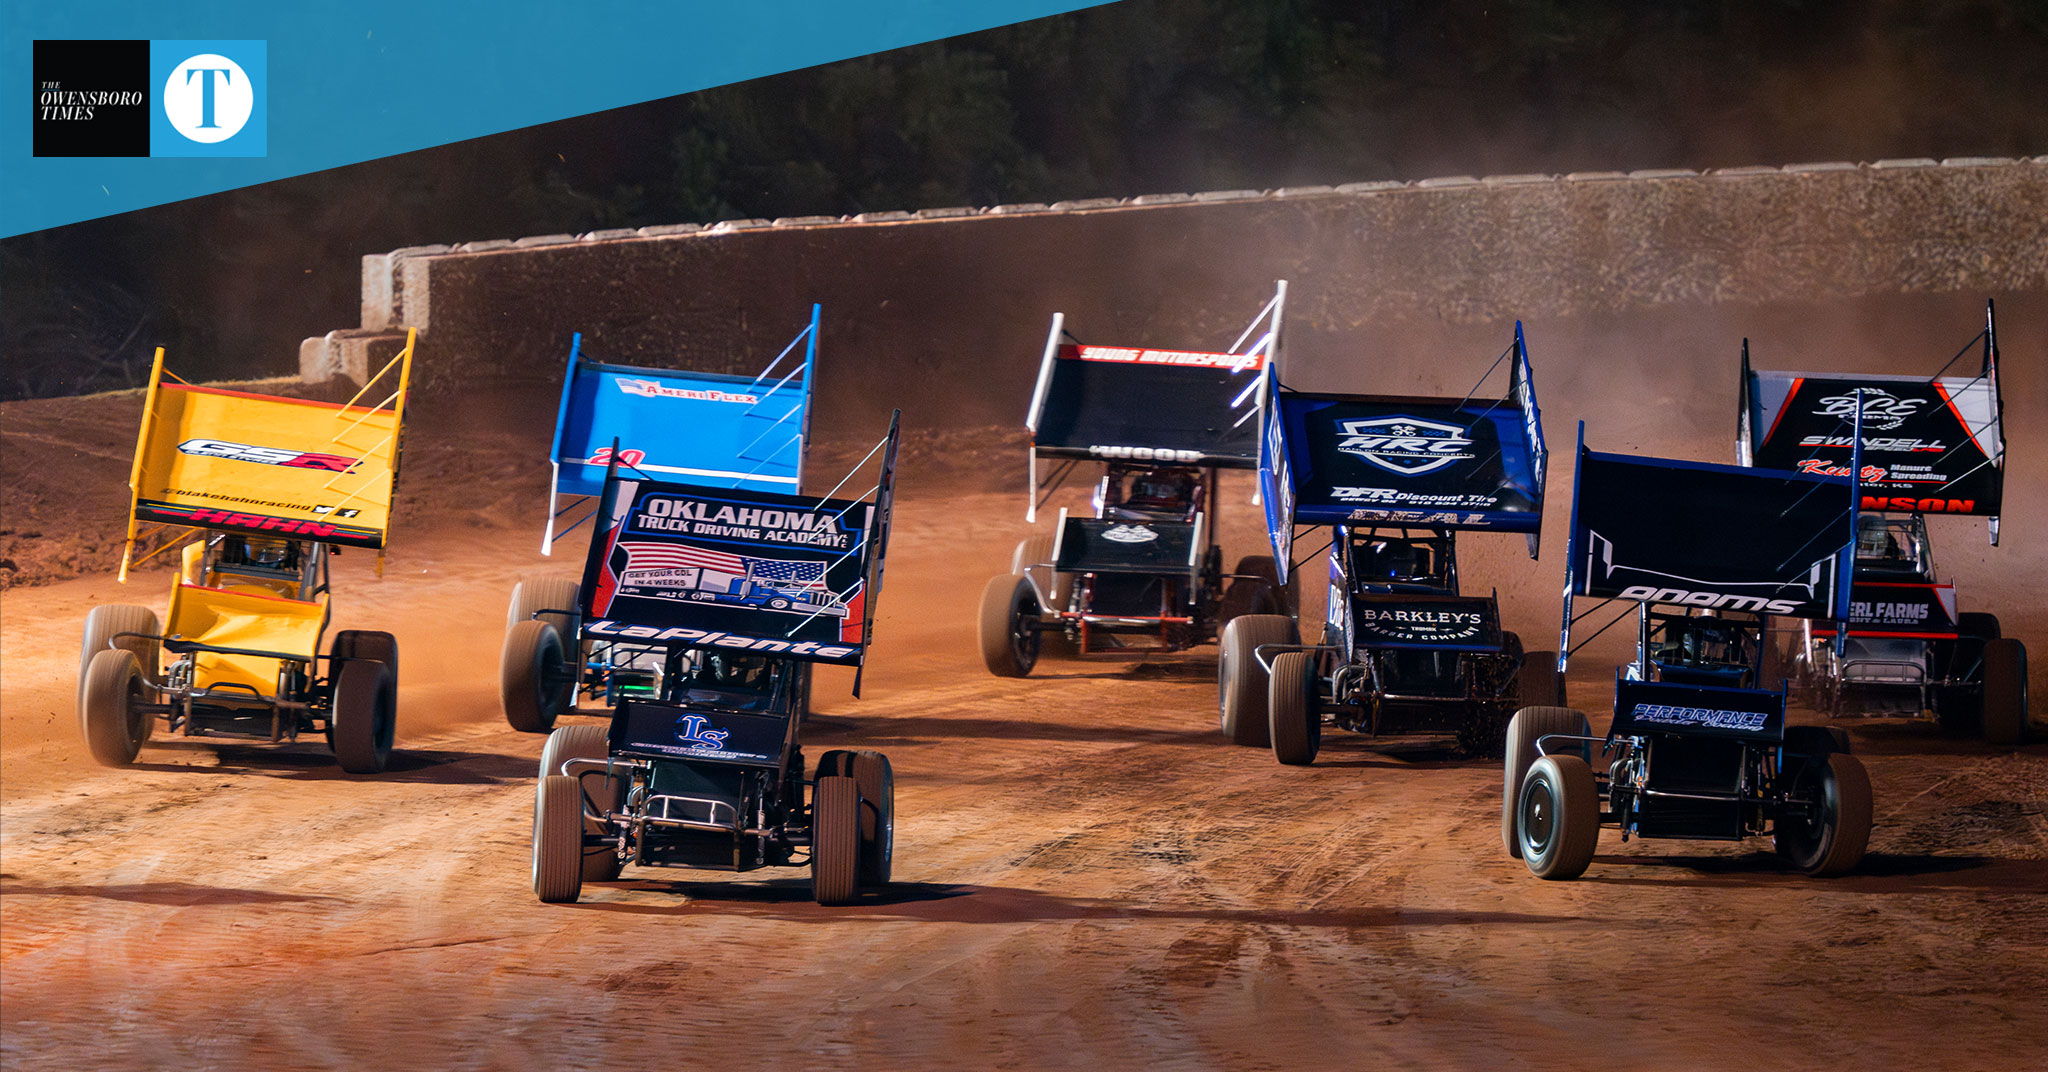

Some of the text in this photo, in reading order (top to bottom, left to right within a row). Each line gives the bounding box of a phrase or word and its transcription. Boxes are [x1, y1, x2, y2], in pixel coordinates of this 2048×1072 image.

[1081, 347, 1141, 361] YOUNG
[1338, 436, 1473, 452] HRC
[178, 439, 363, 474] GSR
[588, 448, 646, 467] 20
[1890, 464, 1932, 472] Manure
[1890, 472, 1947, 481] Spreading
[1330, 486, 1398, 499] DFR
[1396, 492, 1464, 502] Discount
[188, 509, 338, 537] HAHN
[647, 499, 838, 533] OKLAHOMA
[637, 514, 690, 532] TRUCK
[693, 522, 760, 539] DRIVING
[763, 530, 843, 548] ACADEMY
[1618, 586, 1807, 615] ADAMS
[1364, 609, 1481, 624] BARKLEY'S
[1876, 603, 1929, 619] FARMS
[587, 620, 856, 658] LaPlante
[1421, 626, 1480, 641] COMPANY
[1632, 703, 1768, 726] PERFORMANCE
[677, 714, 730, 750] LS
